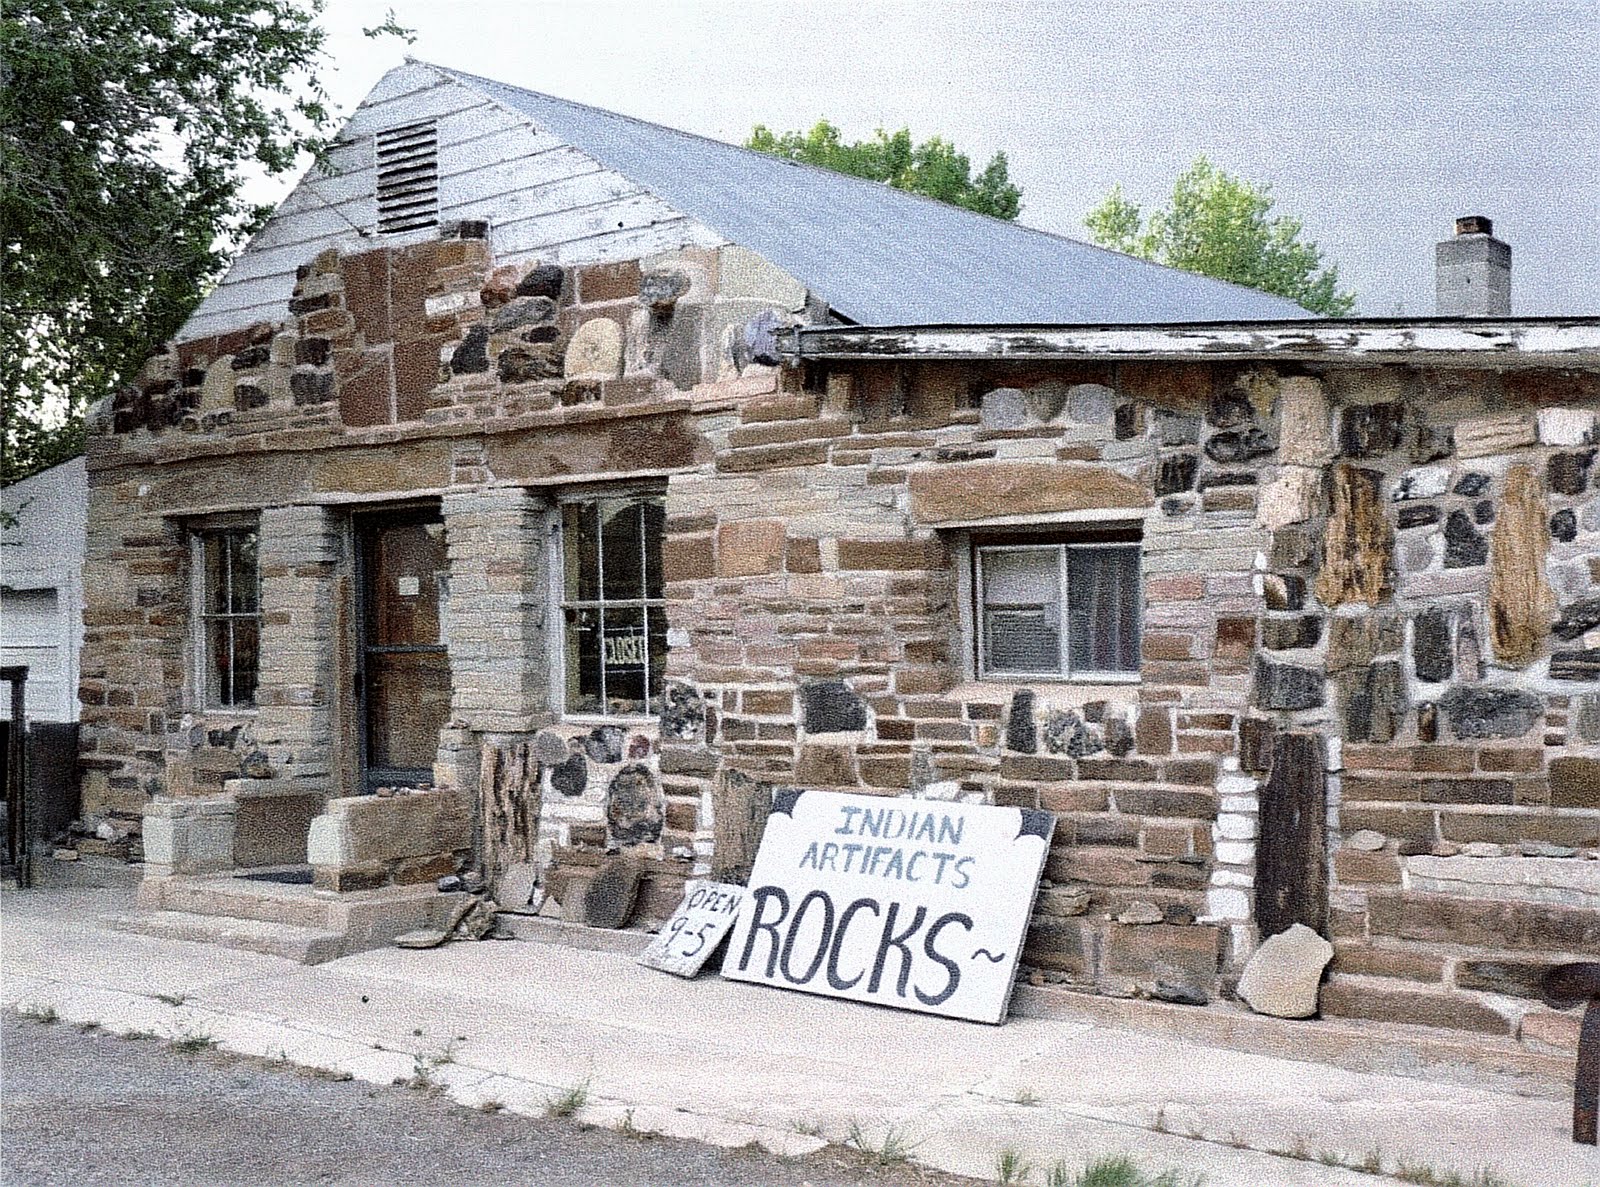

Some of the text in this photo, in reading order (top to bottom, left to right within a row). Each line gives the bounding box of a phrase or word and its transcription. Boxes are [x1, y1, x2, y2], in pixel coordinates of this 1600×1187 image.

[834, 805, 965, 845] INDIAN
[799, 841, 976, 889] ARTIFACTS
[687, 888, 742, 916] OPEN
[664, 917, 716, 957] 9-5
